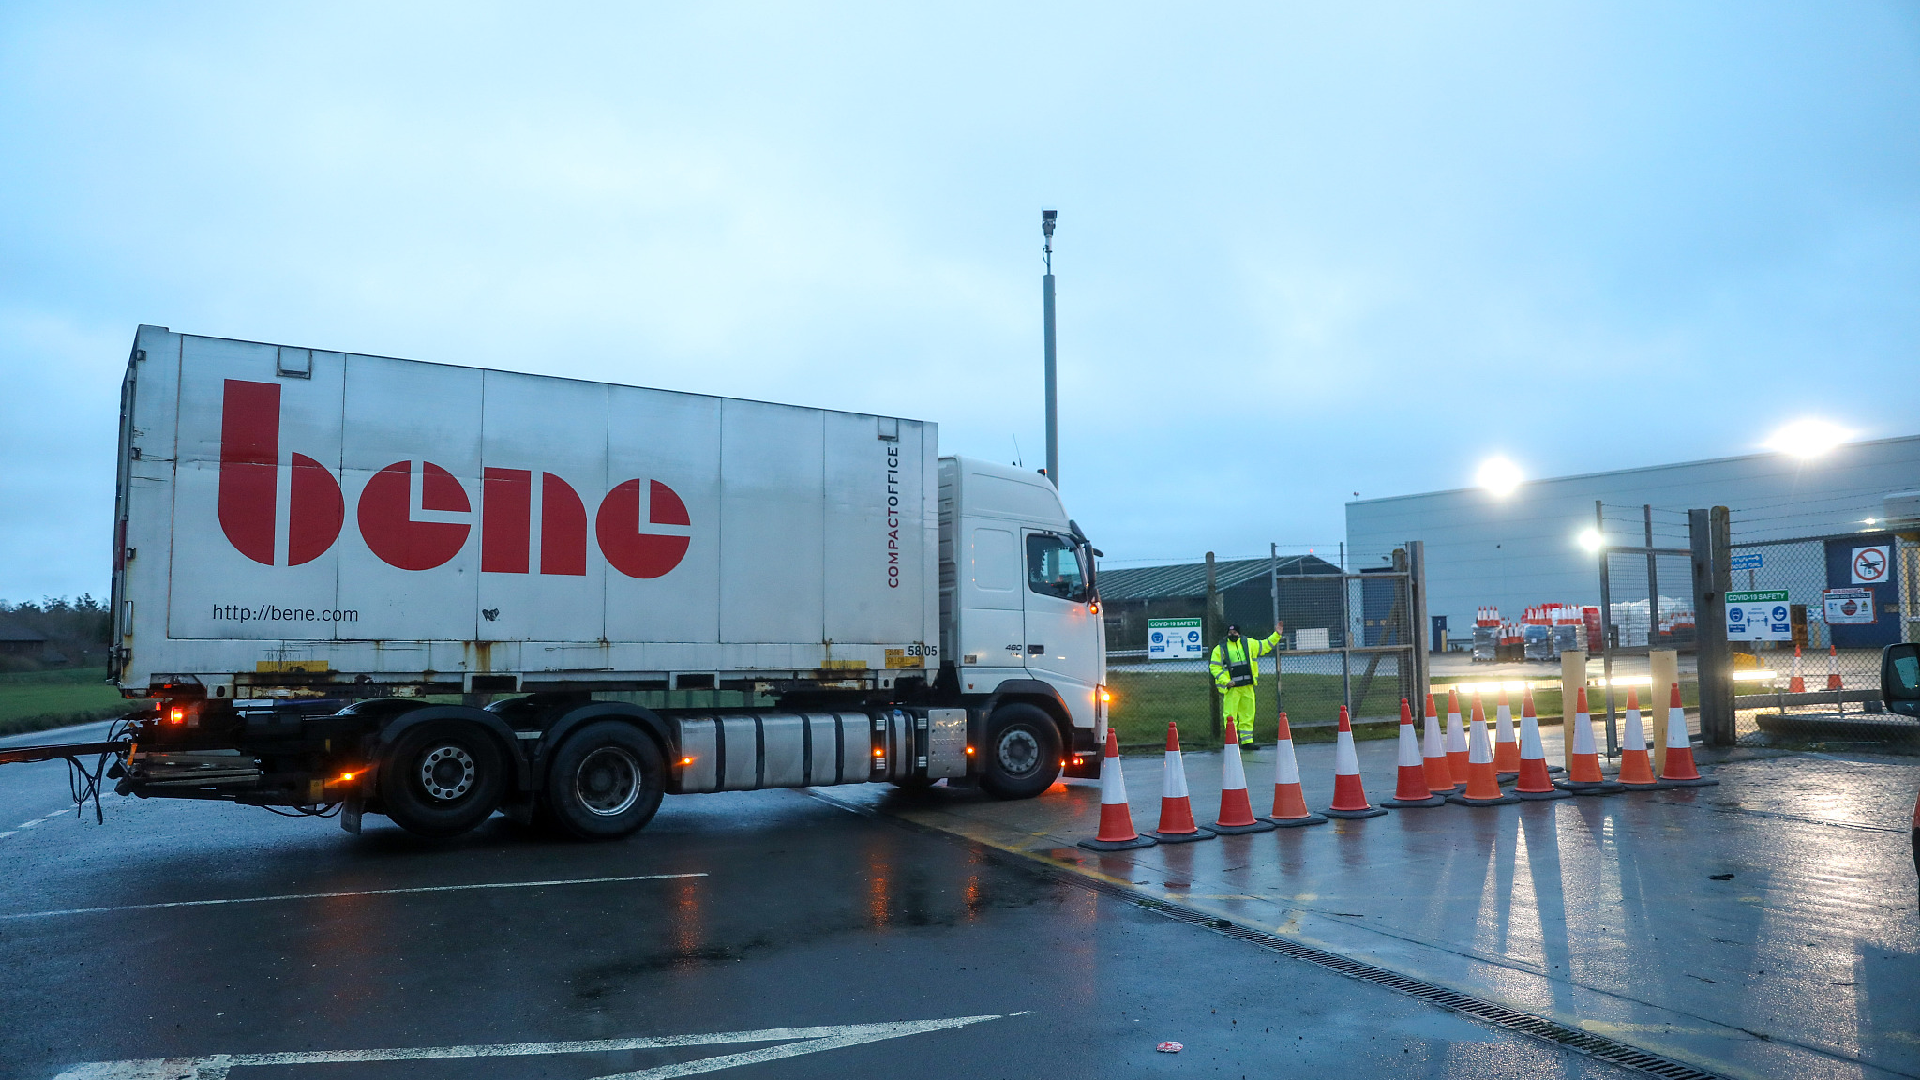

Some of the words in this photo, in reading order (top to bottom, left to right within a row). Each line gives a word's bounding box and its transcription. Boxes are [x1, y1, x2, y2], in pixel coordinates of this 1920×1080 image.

[217, 378, 691, 579] bene
[887, 446, 899, 589] COMPACTOFFICE
[213, 604, 358, 624] http://bene.com
[1728, 594, 1758, 602] COVID-19
[1758, 592, 1785, 600] SAFETY
